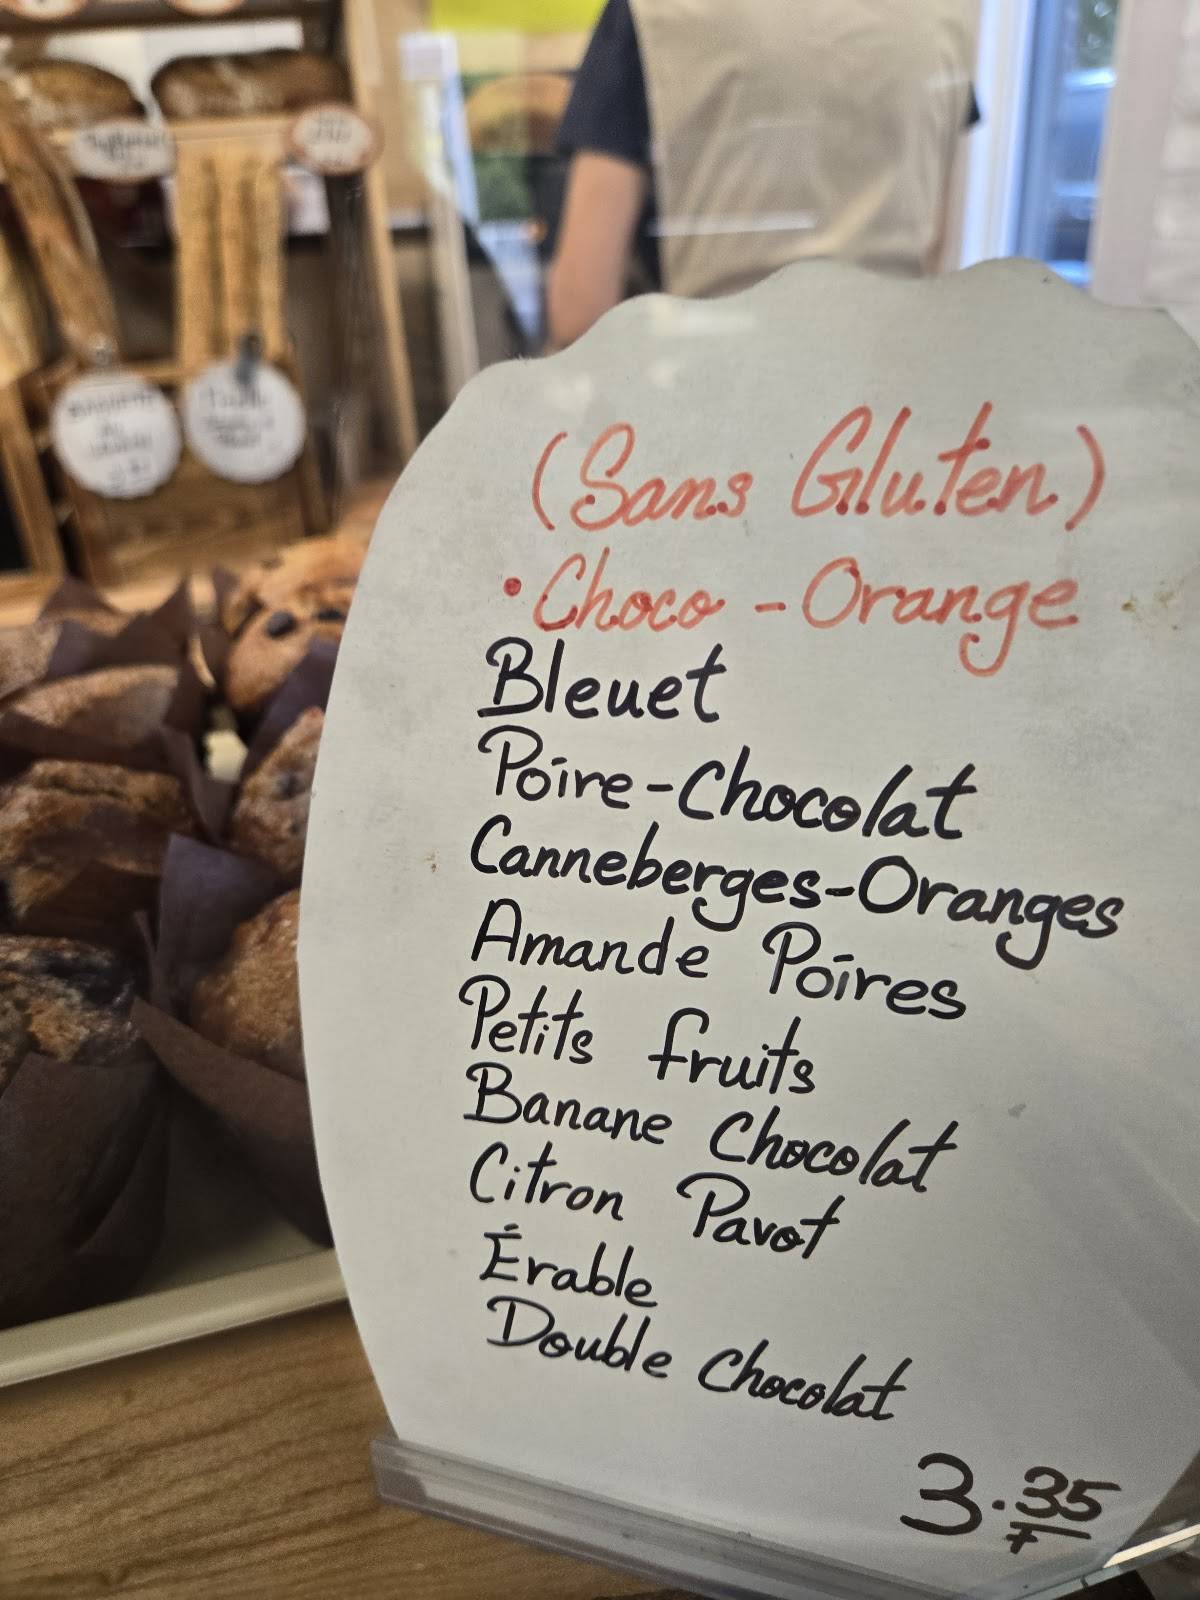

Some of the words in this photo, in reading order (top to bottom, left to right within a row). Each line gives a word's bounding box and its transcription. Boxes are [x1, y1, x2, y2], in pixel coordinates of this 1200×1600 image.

[534, 423, 754, 532] (Sans
[791, 401, 1106, 531] Gluten)
[477, 637, 727, 723] Bleuet
[471, 898, 710, 979] Amande
[762, 922, 968, 1020] Poires
[459, 974, 594, 1064] Petits
[648, 1007, 816, 1095] fruits
[463, 1062, 673, 1145] Banane
[710, 1105, 959, 1193] Chocolat
[470, 1141, 623, 1221] Citron
[676, 1172, 846, 1259] Pavot
[479, 1223, 658, 1308] Érable
[487, 1296, 673, 1380] Double
[698, 1340, 912, 1421] Chocolat
